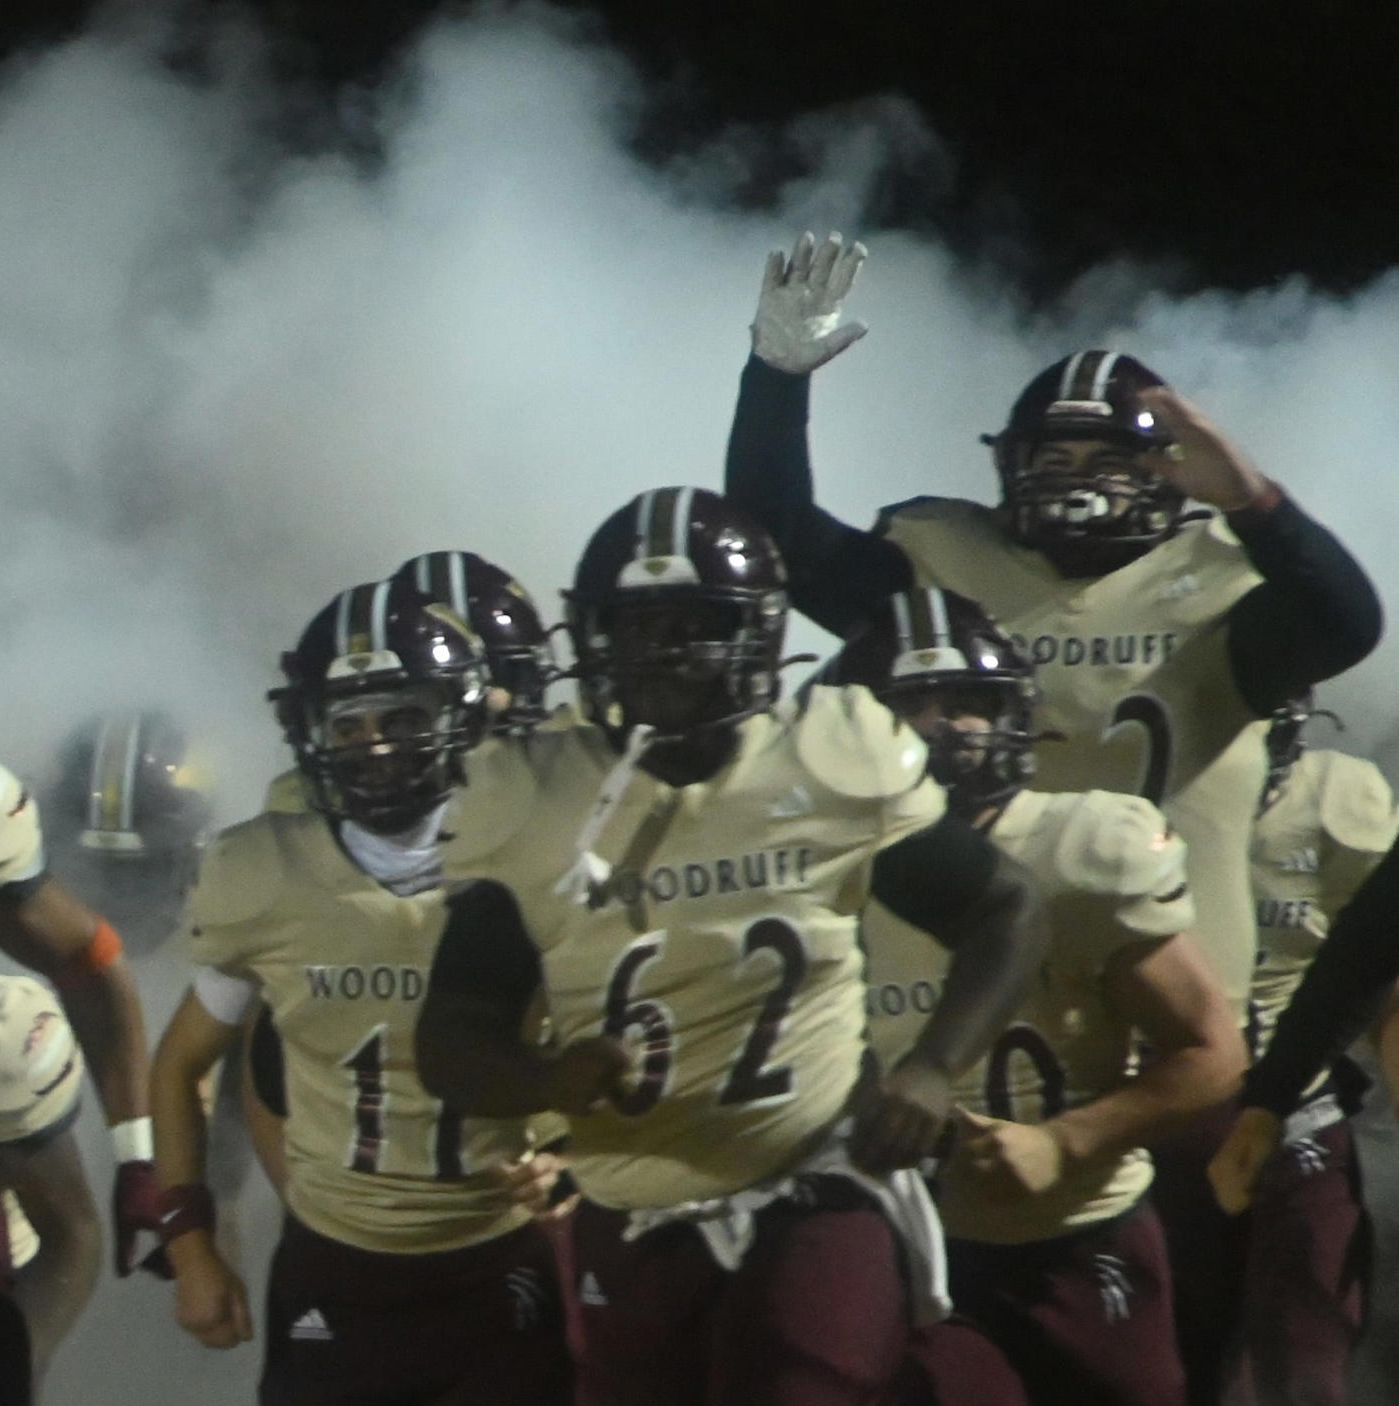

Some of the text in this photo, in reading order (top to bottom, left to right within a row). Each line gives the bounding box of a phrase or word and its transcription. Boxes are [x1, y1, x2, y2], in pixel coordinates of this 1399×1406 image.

[1009, 633, 1177, 667] ODRUFF
[306, 963, 424, 1001] WOOD
[602, 914, 805, 1116] 62
